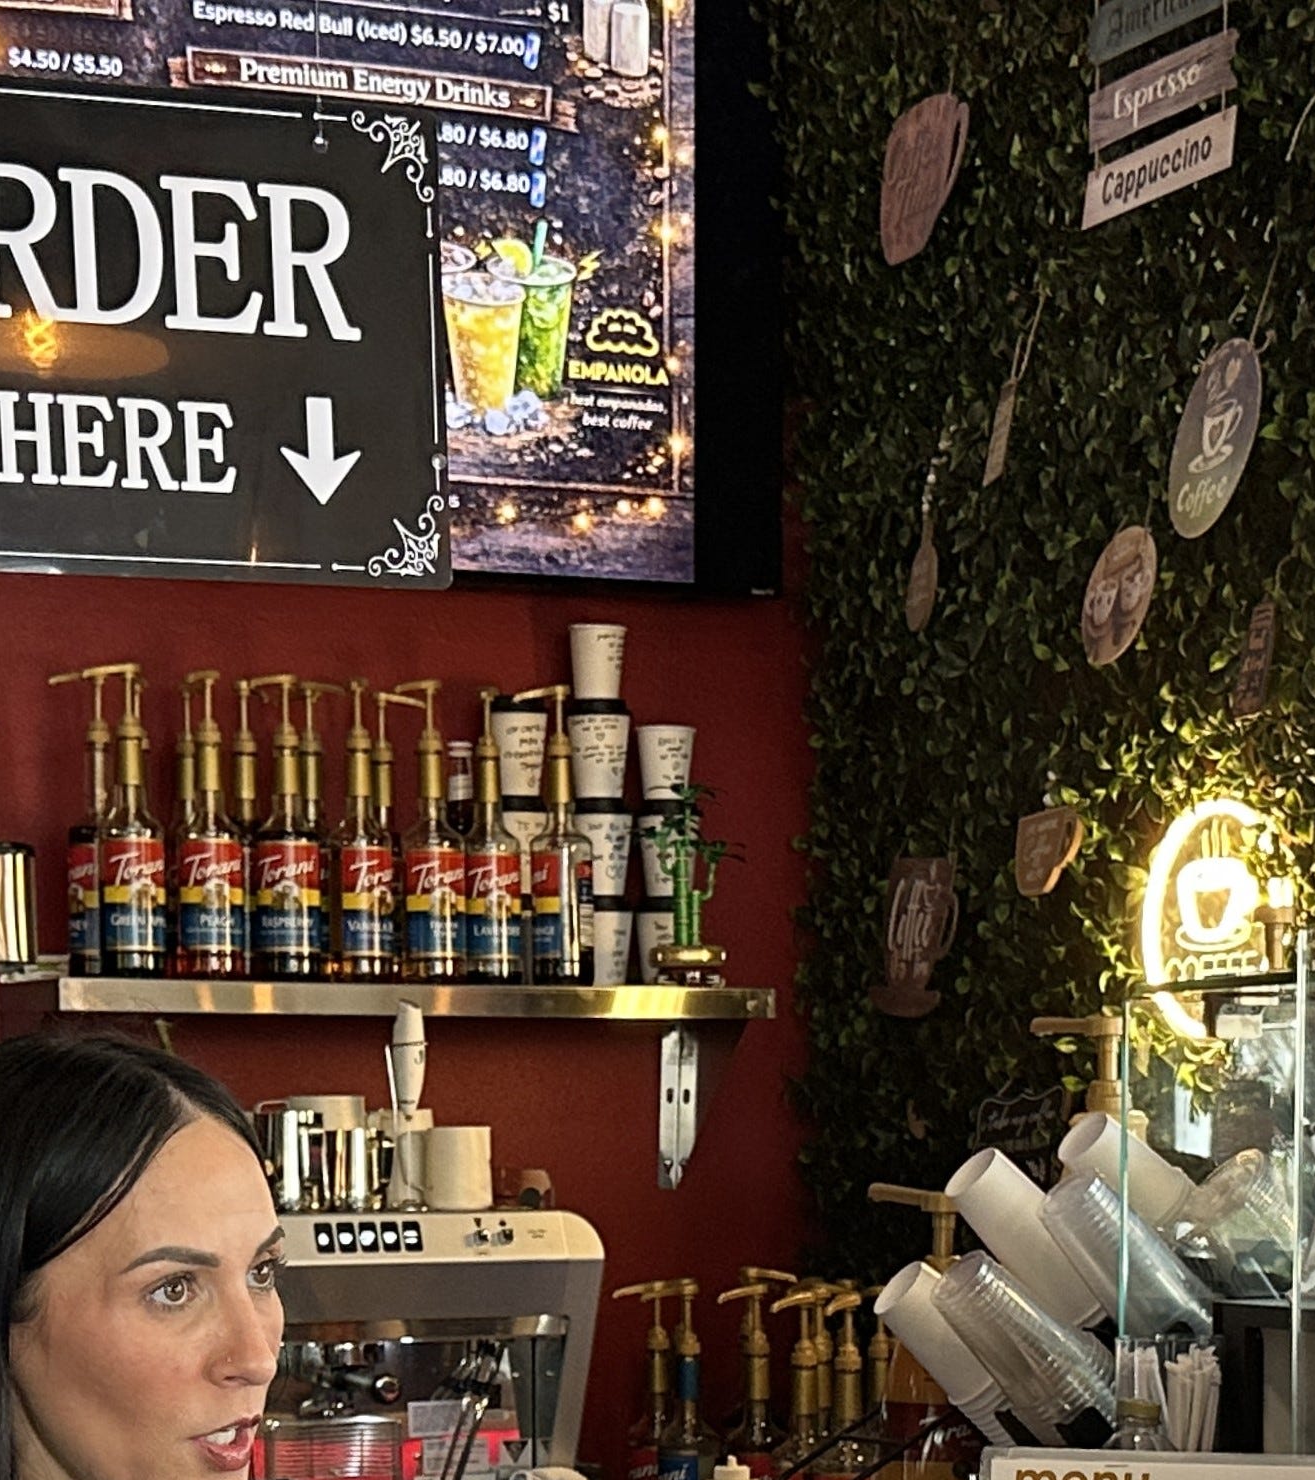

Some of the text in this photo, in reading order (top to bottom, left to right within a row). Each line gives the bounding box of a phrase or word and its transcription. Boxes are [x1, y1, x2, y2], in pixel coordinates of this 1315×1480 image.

[193, 1, 277, 30] Espresso
[280, 10, 316, 34] Red
[319, 14, 354, 38] Bull
[357, 17, 407, 47] (Iced)
[410, 25, 462, 50] $6.50
[475, 32, 525, 58] $7.00
[8, 47, 60, 71] $4.50
[73, 54, 123, 78] $5.50
[239, 56, 511, 110] Premium Energy Drinks
[1113, 62, 1202, 129] Espresso
[437, 123, 466, 145] .80
[479, 125, 529, 152] $6.80
[438, 166, 466, 188] .80
[479, 168, 530, 194] $6.80
[1102, 135, 1213, 206] Cappuccino
[567, 360, 669, 387] EMPANOLA
[1176, 474, 1231, 520] Coffee
[184, 852, 243, 887] Torani
[258, 854, 316, 889] Torani
[349, 859, 394, 893] Tora
[411, 860, 465, 895] Toran
